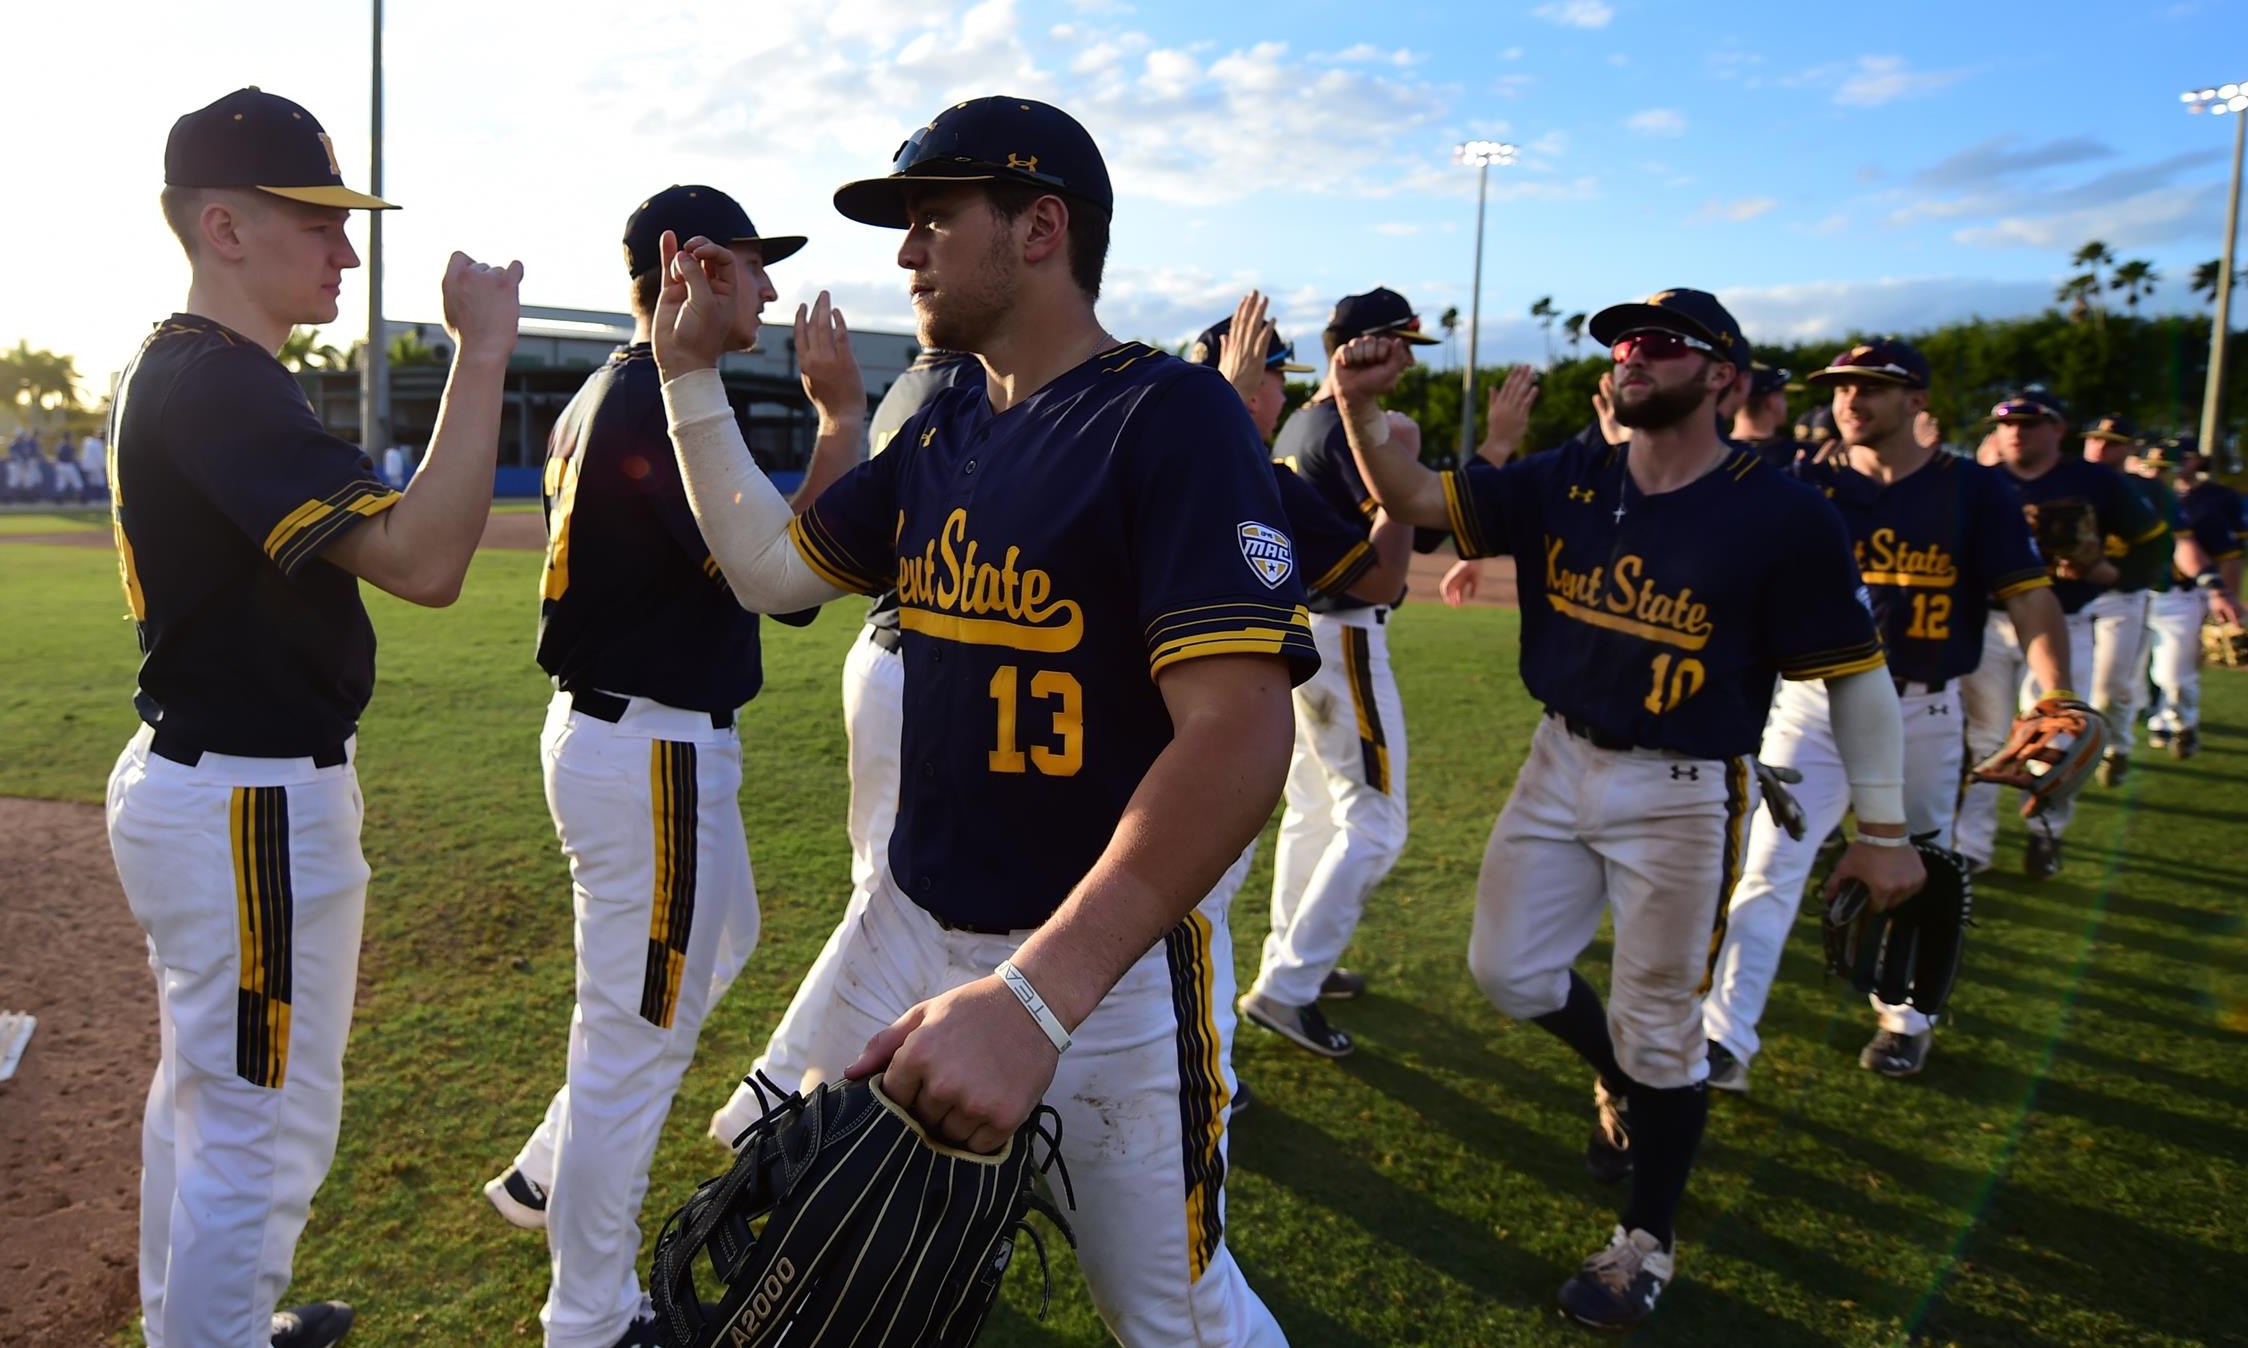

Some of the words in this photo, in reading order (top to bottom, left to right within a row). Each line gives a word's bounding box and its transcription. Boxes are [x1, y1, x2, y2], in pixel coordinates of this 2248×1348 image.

[896, 509, 936, 607] ent
[937, 507, 1058, 624] State
[1243, 539, 1291, 561] MAC
[1868, 527, 1953, 575] State
[1606, 554, 1709, 633] State
[1906, 593, 1952, 639] 12
[1644, 652, 1705, 714] 10
[988, 665, 1084, 777] 13
[729, 1256, 796, 1348] A2000
